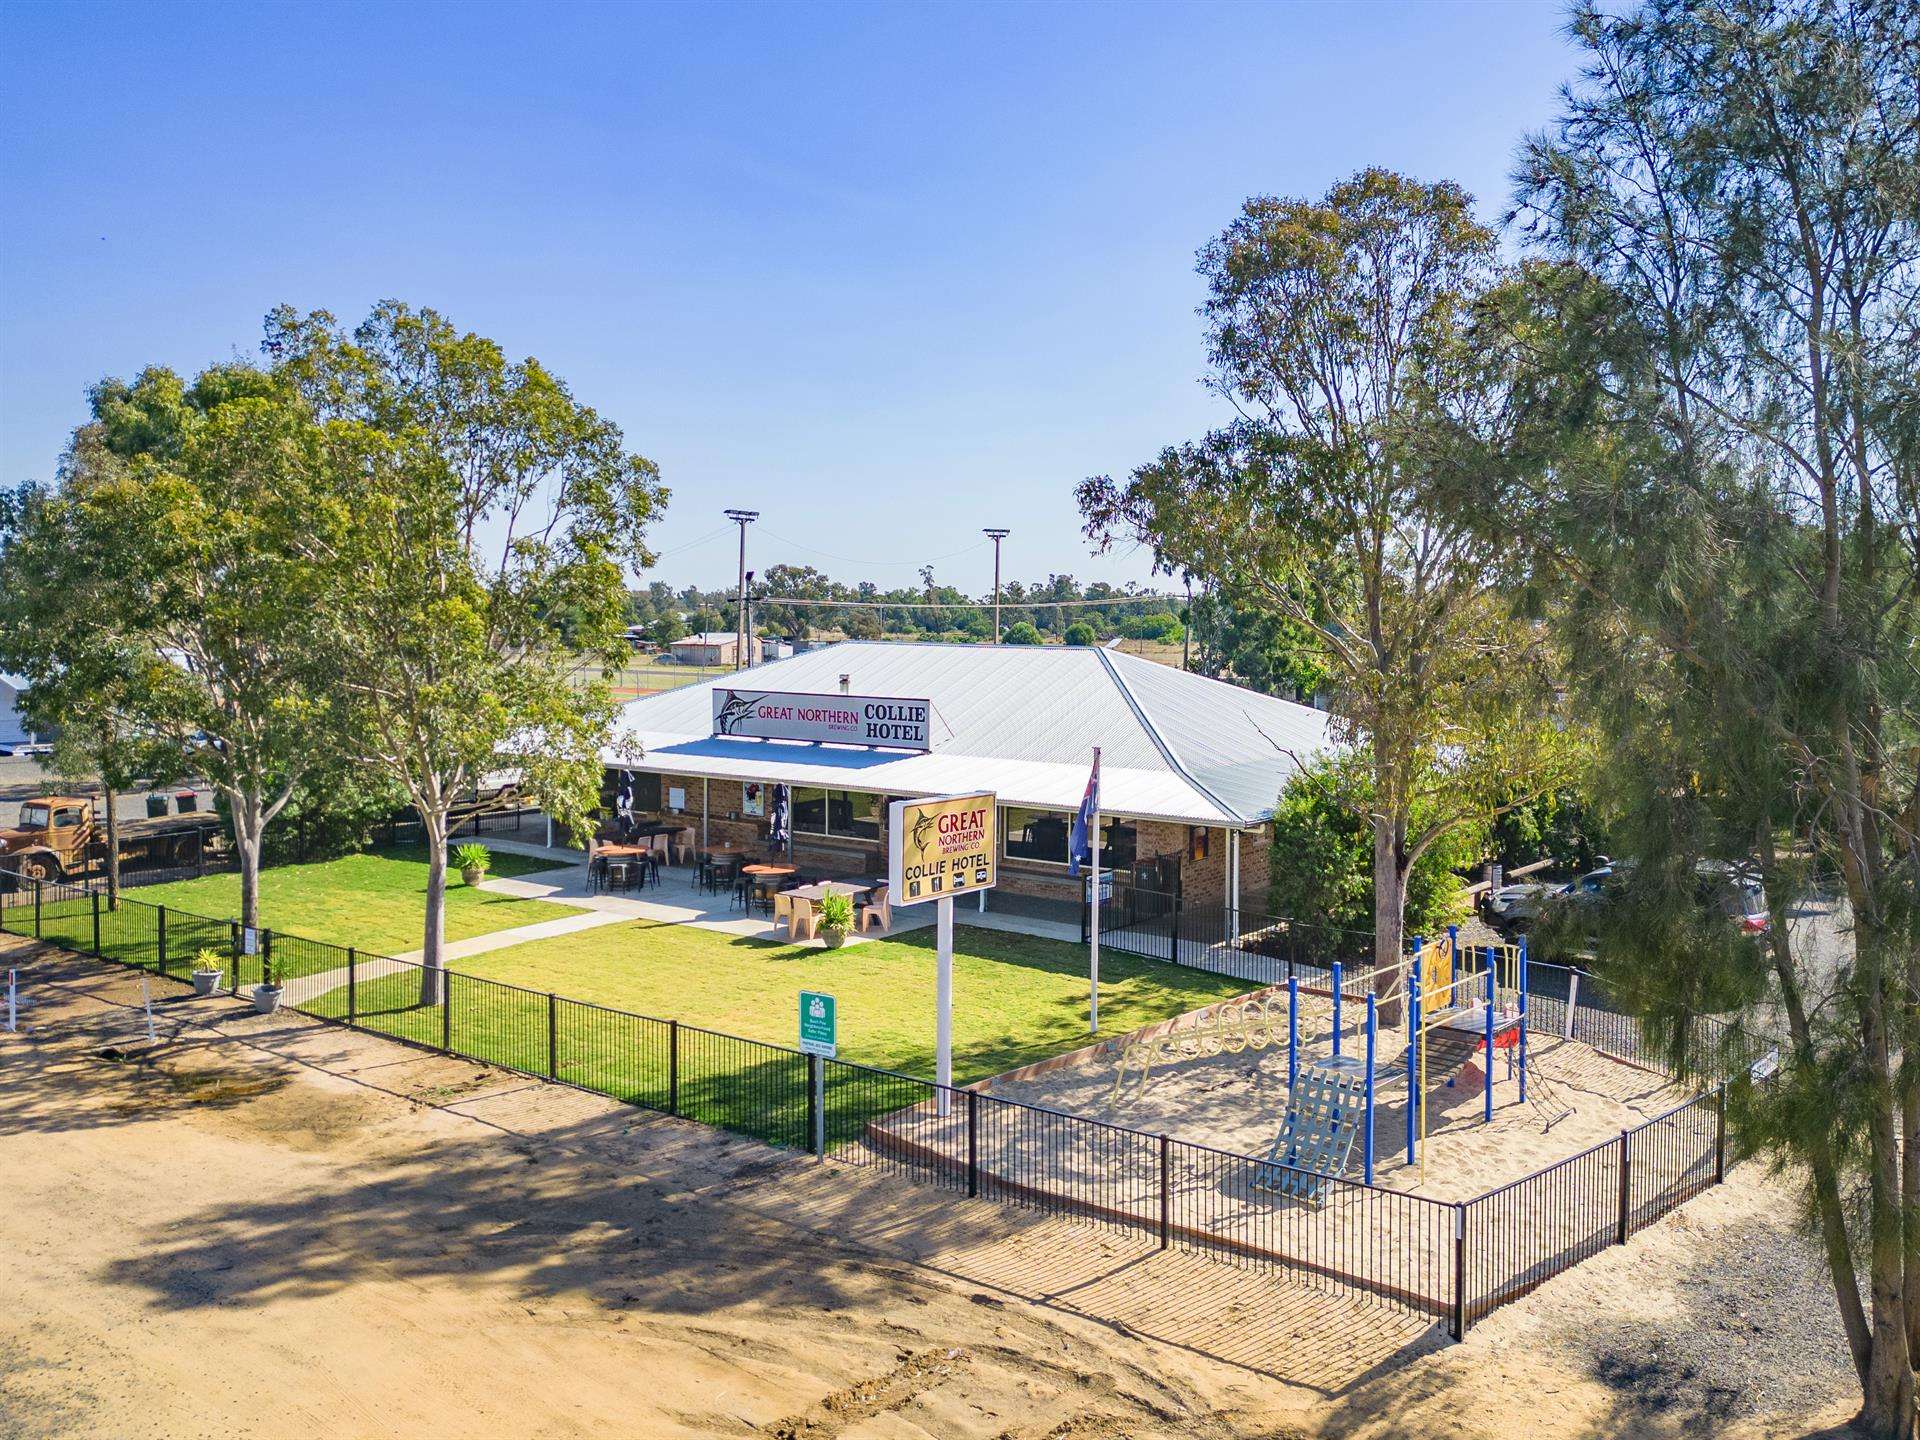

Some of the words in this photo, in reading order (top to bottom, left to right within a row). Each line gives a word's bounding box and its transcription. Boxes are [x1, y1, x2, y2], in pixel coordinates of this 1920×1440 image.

[758, 706, 793, 720] GREAT
[797, 708, 859, 724] NORTHERN
[864, 703, 926, 723] COLLIE
[866, 723, 924, 741] HOTEL
[938, 809, 986, 833] GREAT
[939, 829, 984, 846] NORTHERN
[942, 844, 968, 854] BREWING
[906, 860, 946, 880] COLLIE
[952, 853, 989, 871] HOTEL
